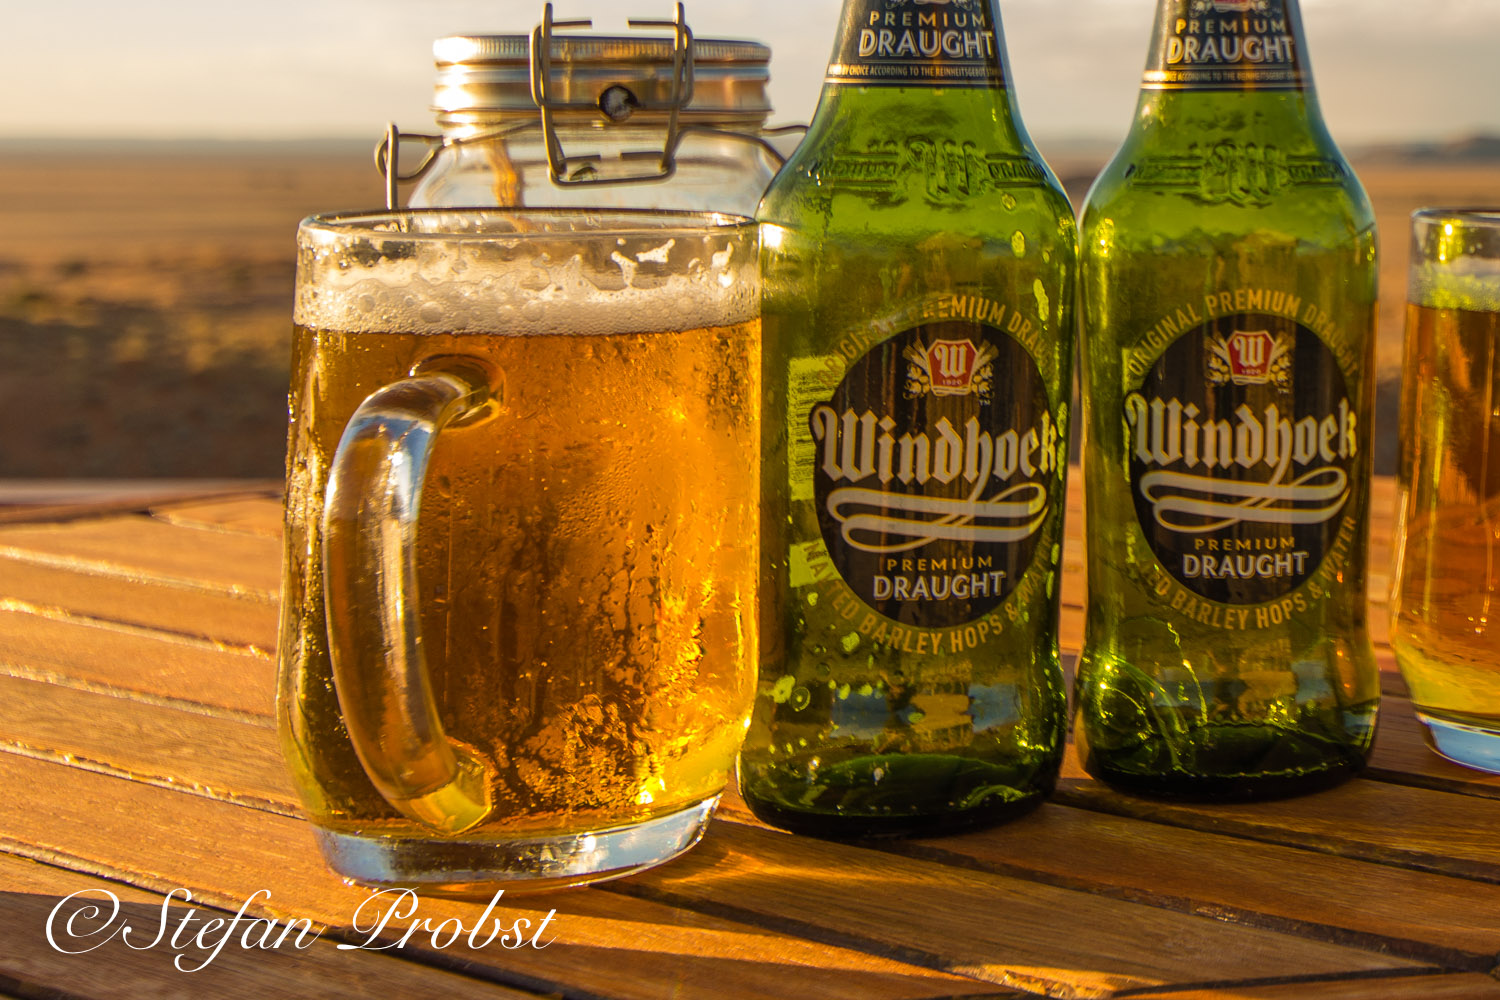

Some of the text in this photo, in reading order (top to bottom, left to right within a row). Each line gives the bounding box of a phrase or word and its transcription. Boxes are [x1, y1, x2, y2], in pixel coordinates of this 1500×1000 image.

[868, 10, 987, 28] PREMIUM
[1174, 18, 1287, 35] PREMIUM
[858, 28, 994, 58] DRAUGHT
[1166, 35, 1295, 64] DRAUGHT
[869, 64, 908, 77] ACCORDING
[909, 65, 920, 77] TO
[921, 65, 935, 77] THE
[1128, 288, 1358, 377] ORIGINAL PREMIUM DRAUGHT
[934, 343, 968, 378] W
[1233, 335, 1265, 368] W
[812, 404, 1058, 503] Windhoek
[1124, 392, 1358, 488] Windhoek
[1194, 537, 1295, 551] PREMIUM
[887, 555, 993, 572] PREMIUM
[1170, 589, 1249, 630] BARLEY
[1255, 592, 1307, 629] HOPS
[1319, 515, 1356, 581] WATER
[1182, 551, 1309, 579] DRAUGHT
[873, 571, 1006, 601] DRAUGHT
[859, 613, 943, 655] BARLEY
[950, 614, 1003, 653] HOPS
